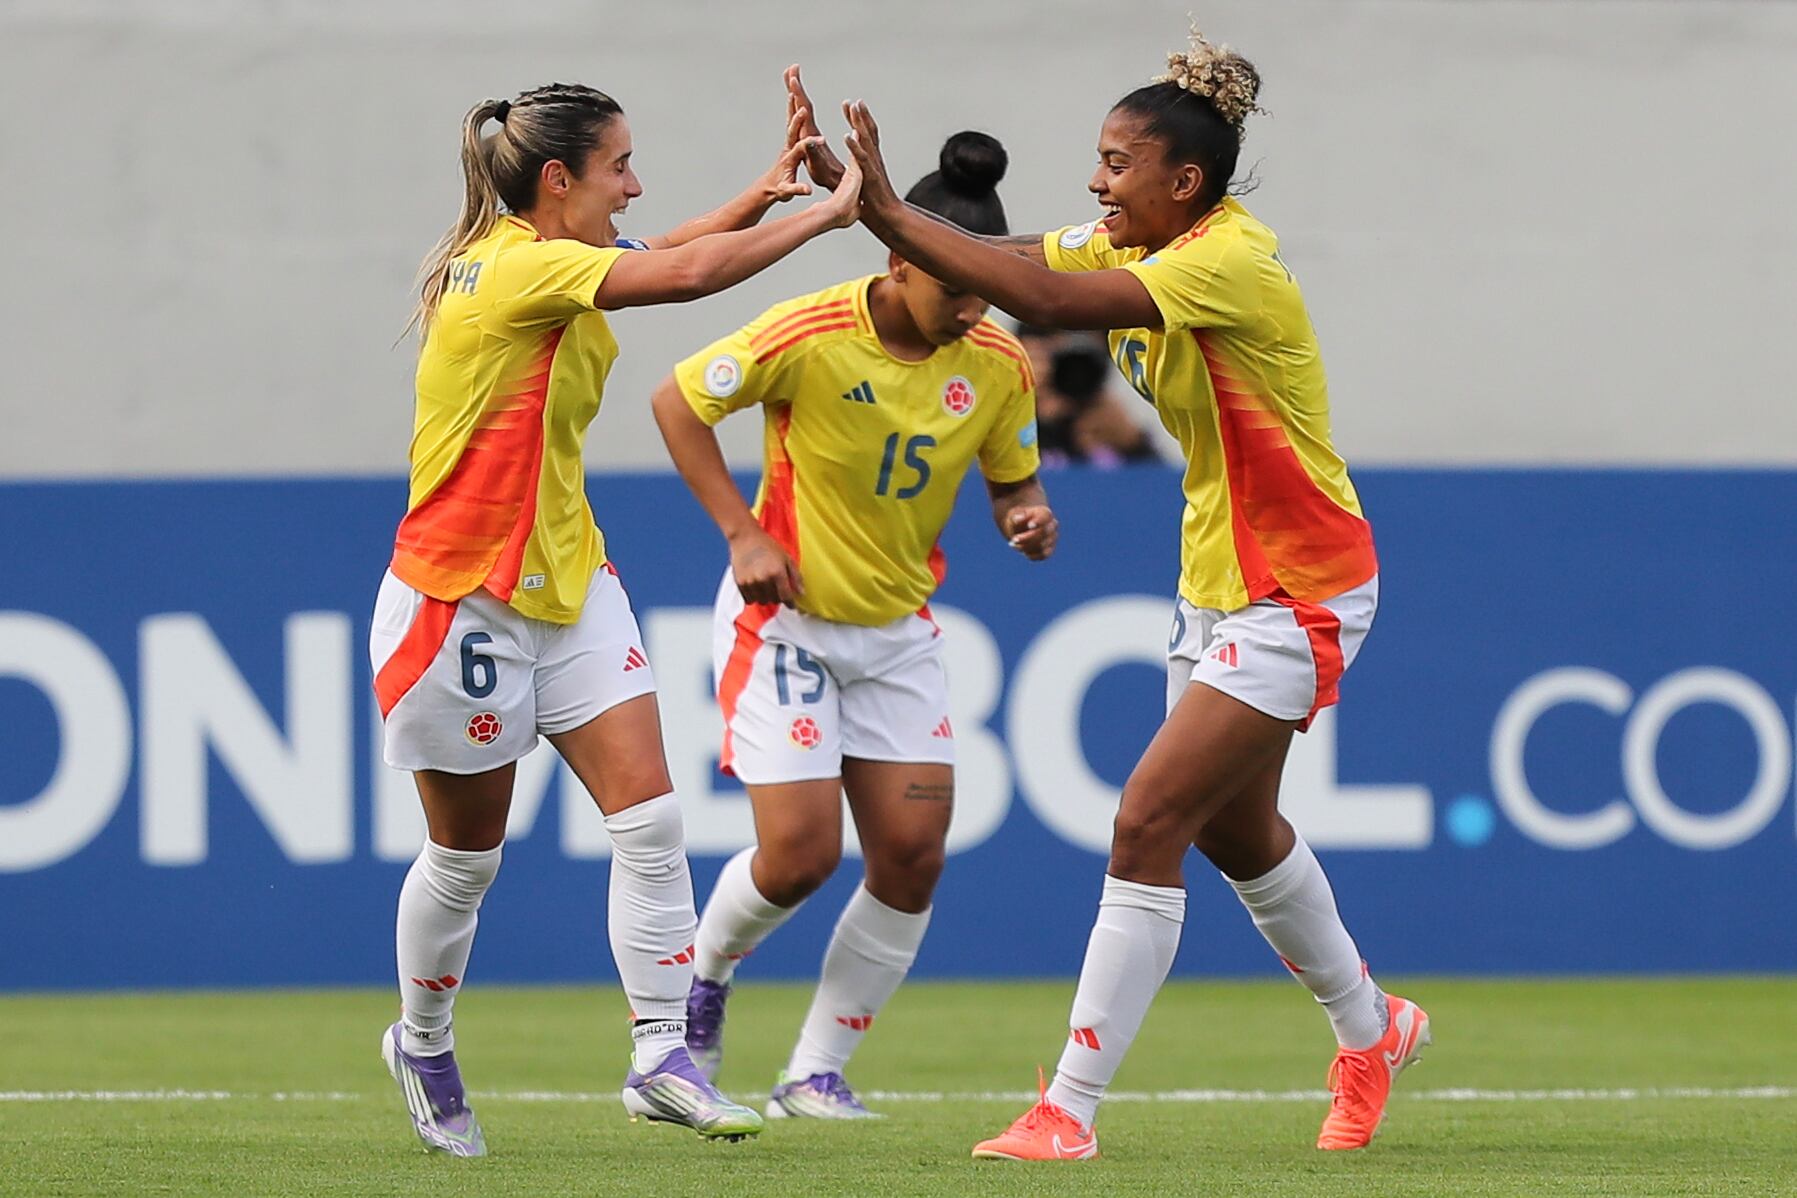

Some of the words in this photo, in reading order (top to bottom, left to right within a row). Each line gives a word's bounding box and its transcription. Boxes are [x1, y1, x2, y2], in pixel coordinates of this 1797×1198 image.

[451, 261, 484, 296] YA
[1117, 335, 1156, 405] 16
[875, 431, 937, 499] 15
[460, 631, 497, 699] 6
[775, 643, 827, 706] 15
